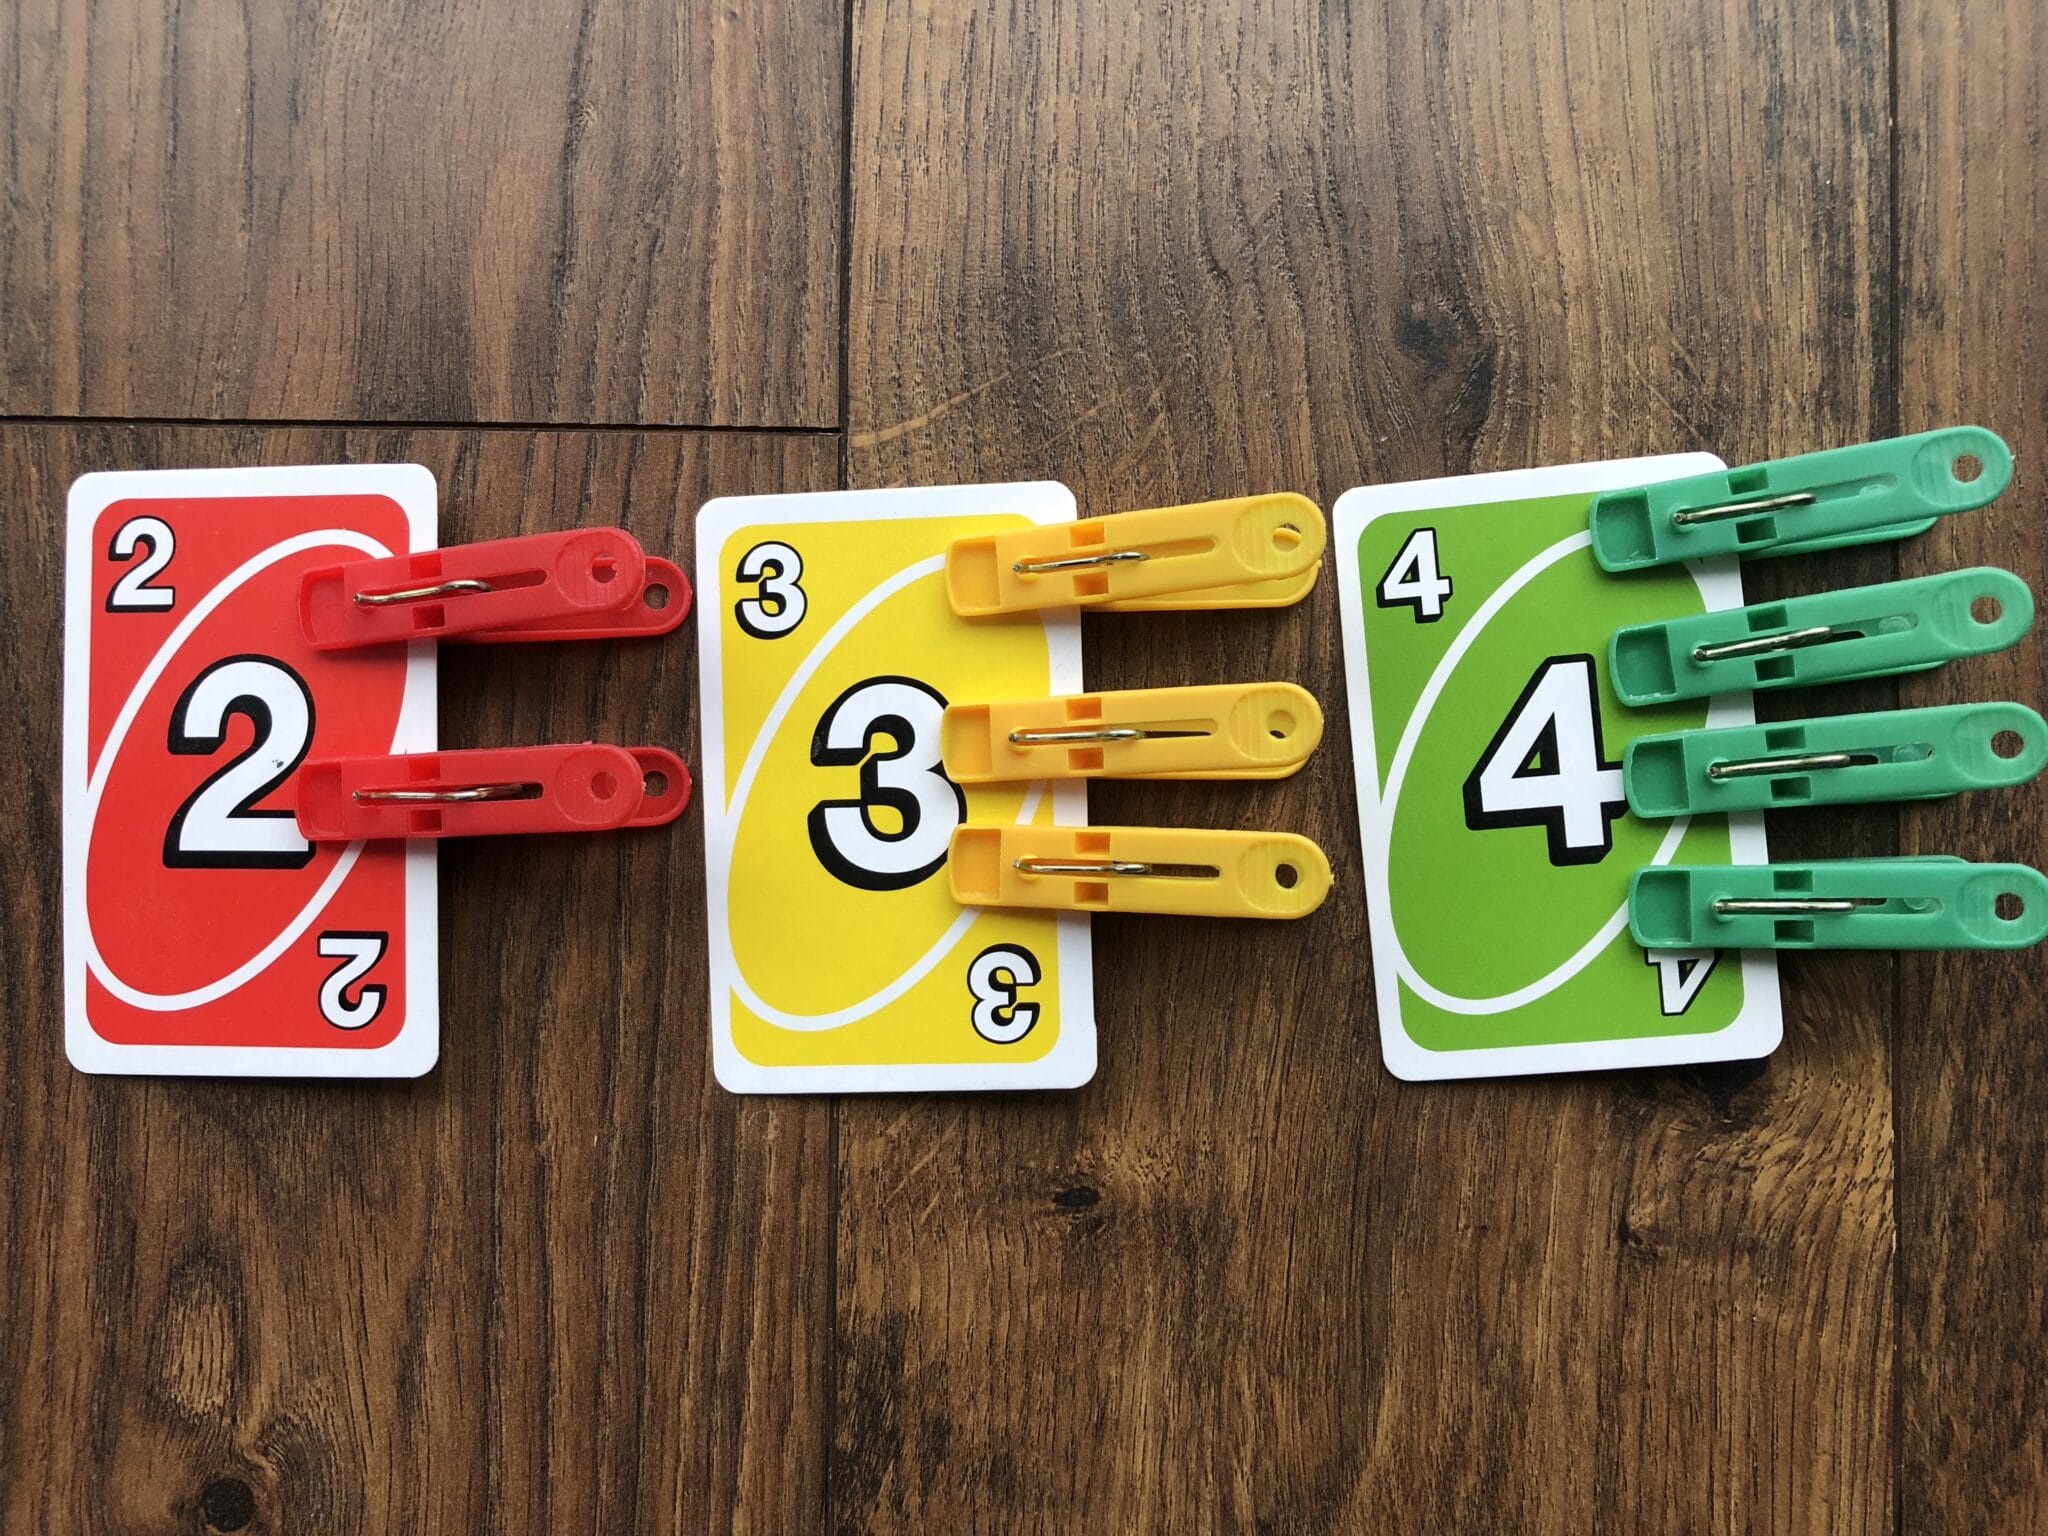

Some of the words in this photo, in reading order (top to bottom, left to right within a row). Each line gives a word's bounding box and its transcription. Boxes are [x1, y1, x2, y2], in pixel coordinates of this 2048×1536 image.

[106, 515, 176, 613] 2
[734, 541, 807, 640] 3
[1376, 527, 1452, 624] 4
[162, 653, 316, 869] 2
[807, 674, 967, 891] 3
[1462, 653, 1630, 867] 4
[317, 930, 389, 1030] 2
[966, 943, 1042, 1045] 3
